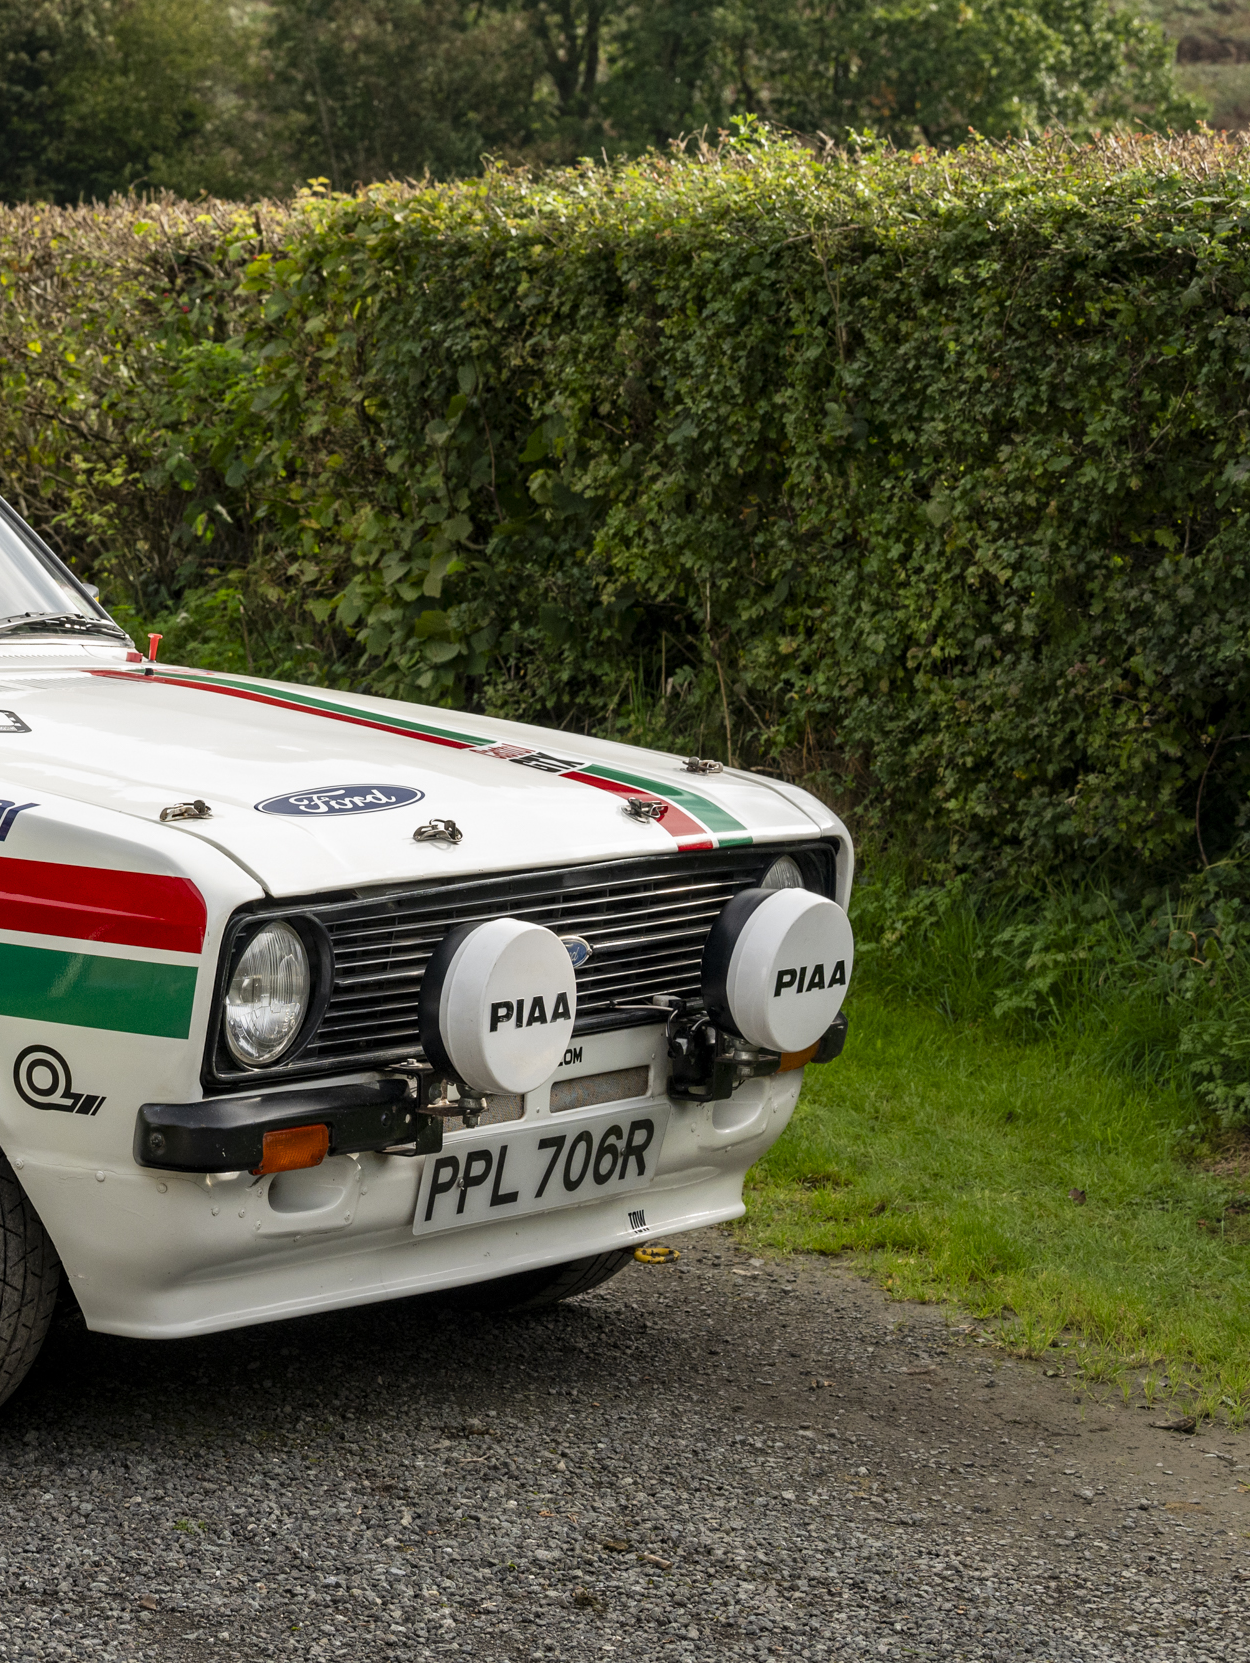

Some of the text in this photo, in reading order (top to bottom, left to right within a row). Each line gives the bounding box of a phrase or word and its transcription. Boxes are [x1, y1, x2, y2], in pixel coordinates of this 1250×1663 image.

[508, 752, 586, 773] GTX
[289, 789, 397, 814] Ford
[773, 960, 847, 998] PIAA
[489, 991, 572, 1033] PIAA
[424, 1118, 655, 1222] PPL 706R
[628, 1209, 650, 1234] TOW
